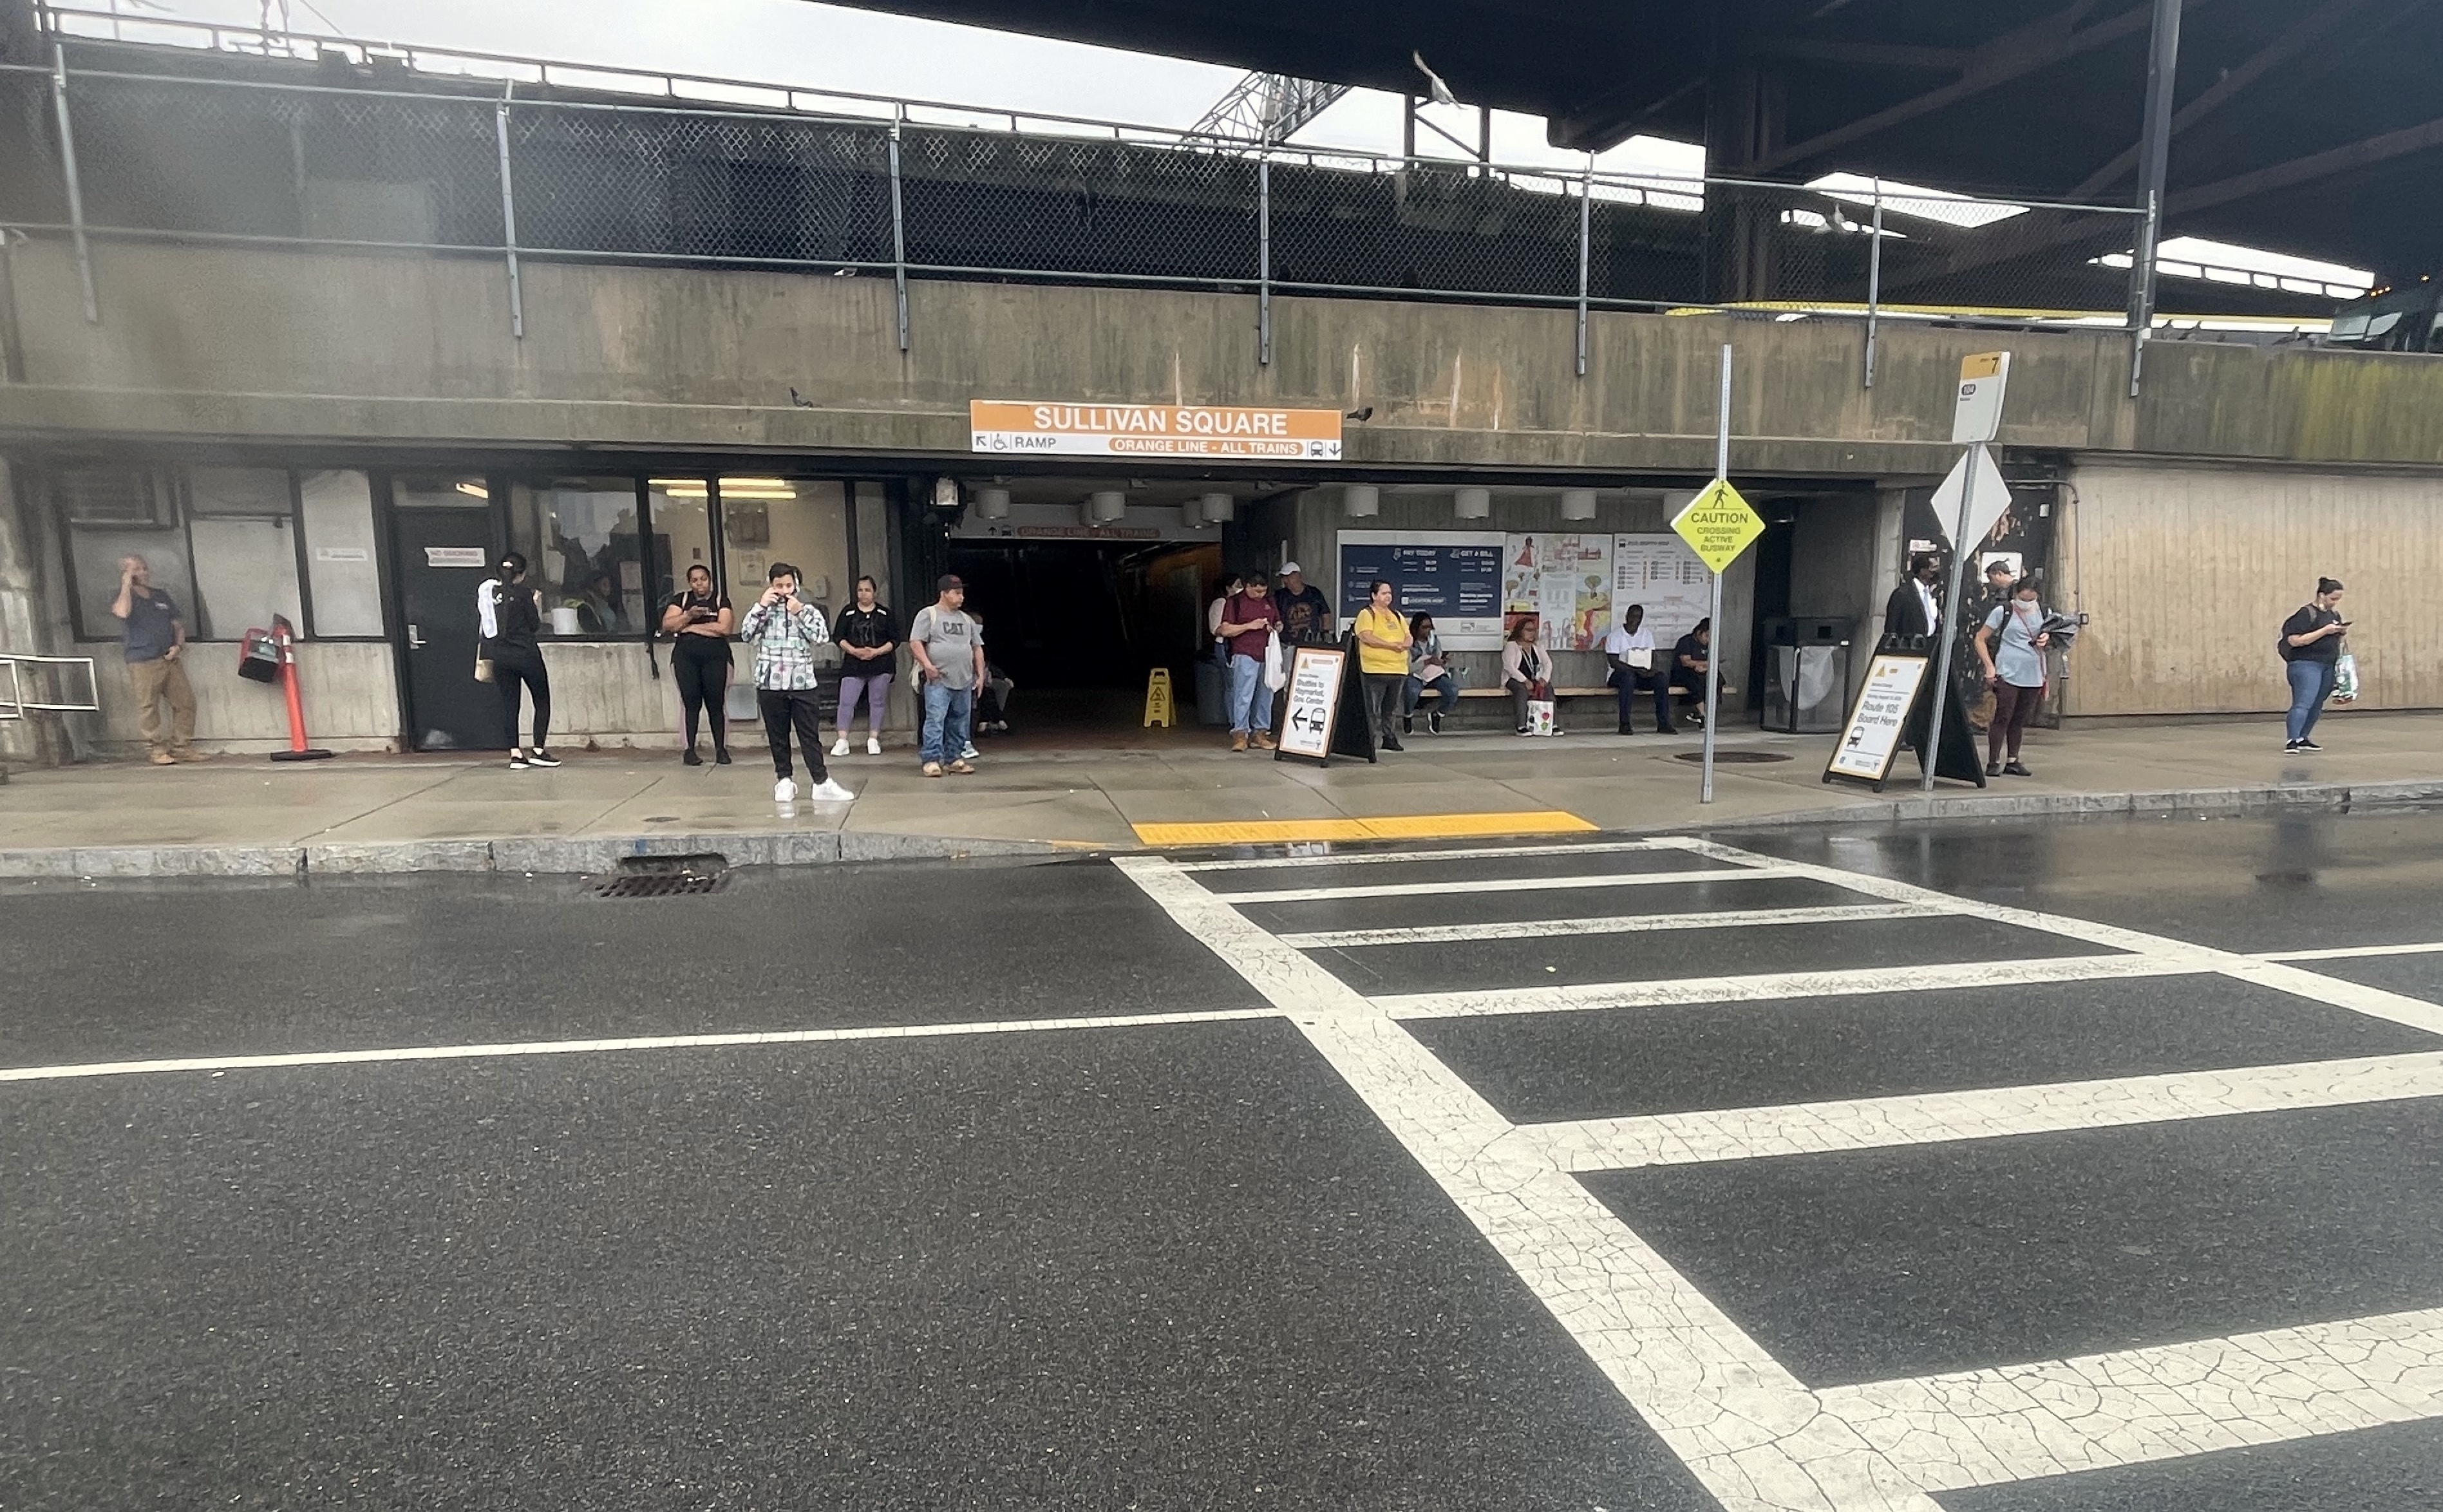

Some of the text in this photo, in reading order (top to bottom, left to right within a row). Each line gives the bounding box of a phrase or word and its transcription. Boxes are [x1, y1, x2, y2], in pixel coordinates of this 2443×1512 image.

[1992, 357, 1999, 374] 7
[1033, 407, 1287, 435] SULLIVAN SQUARE
[1015, 437, 1056, 449] RAMP
[1115, 439, 1174, 452] ORANGE
[1178, 440, 1208, 453] LINE
[1221, 442, 1246, 454] ALL
[1249, 442, 1297, 455] TRAINS
[1691, 513, 1748, 524] CAUTION
[1021, 527, 1065, 536] ORANGE
[1099, 529, 1118, 537] ALL
[1120, 529, 1157, 538] TRAINS
[942, 621, 964, 636] CAT
[1861, 700, 1885, 712] Route
[1856, 712, 1898, 727] Board Here
